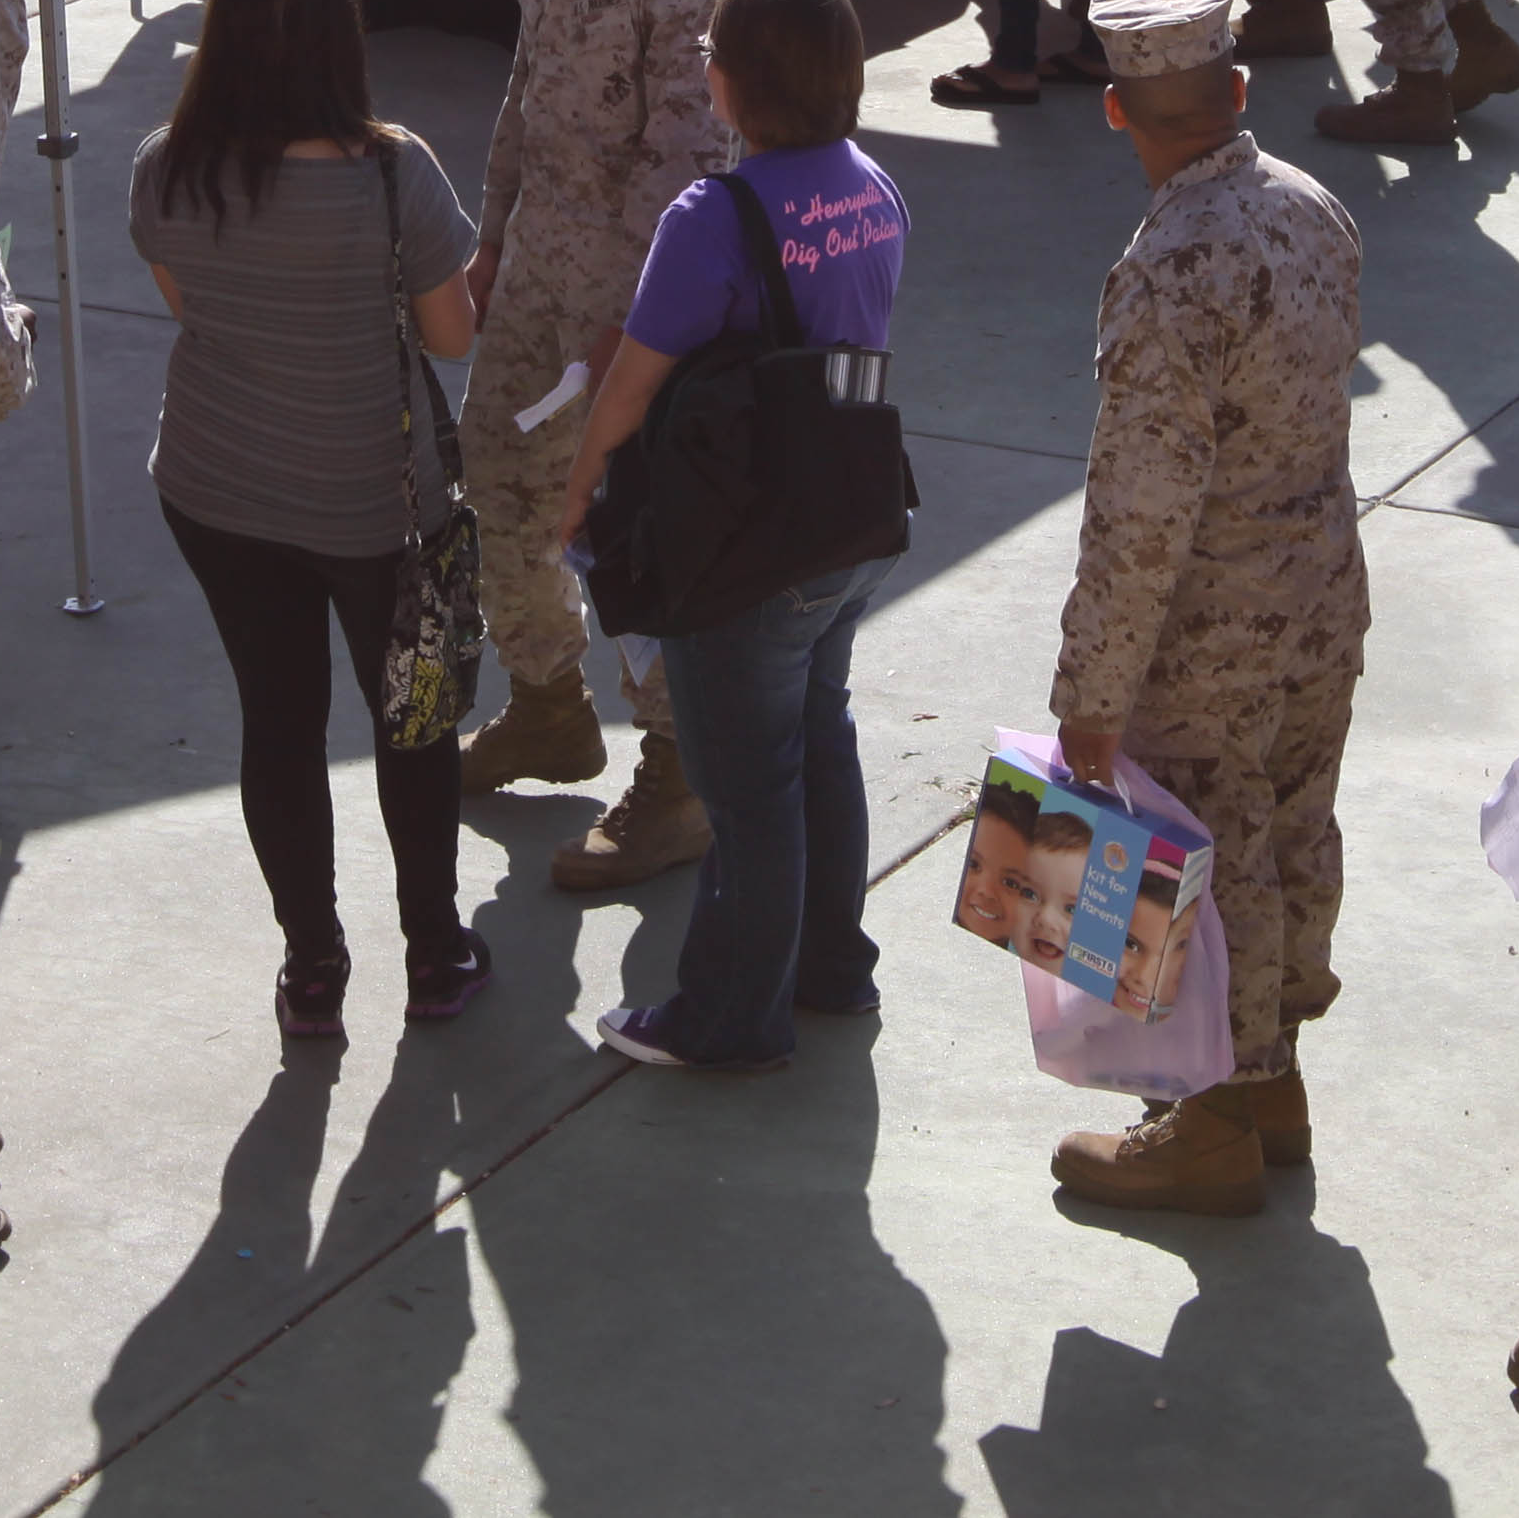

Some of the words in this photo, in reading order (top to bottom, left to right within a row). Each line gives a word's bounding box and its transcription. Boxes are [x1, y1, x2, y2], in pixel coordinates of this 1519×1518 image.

[782, 239, 820, 274] Pig
[825, 222, 859, 257] Out
[1083, 881, 1108, 904] New
[1080, 897, 1125, 930] Parents
